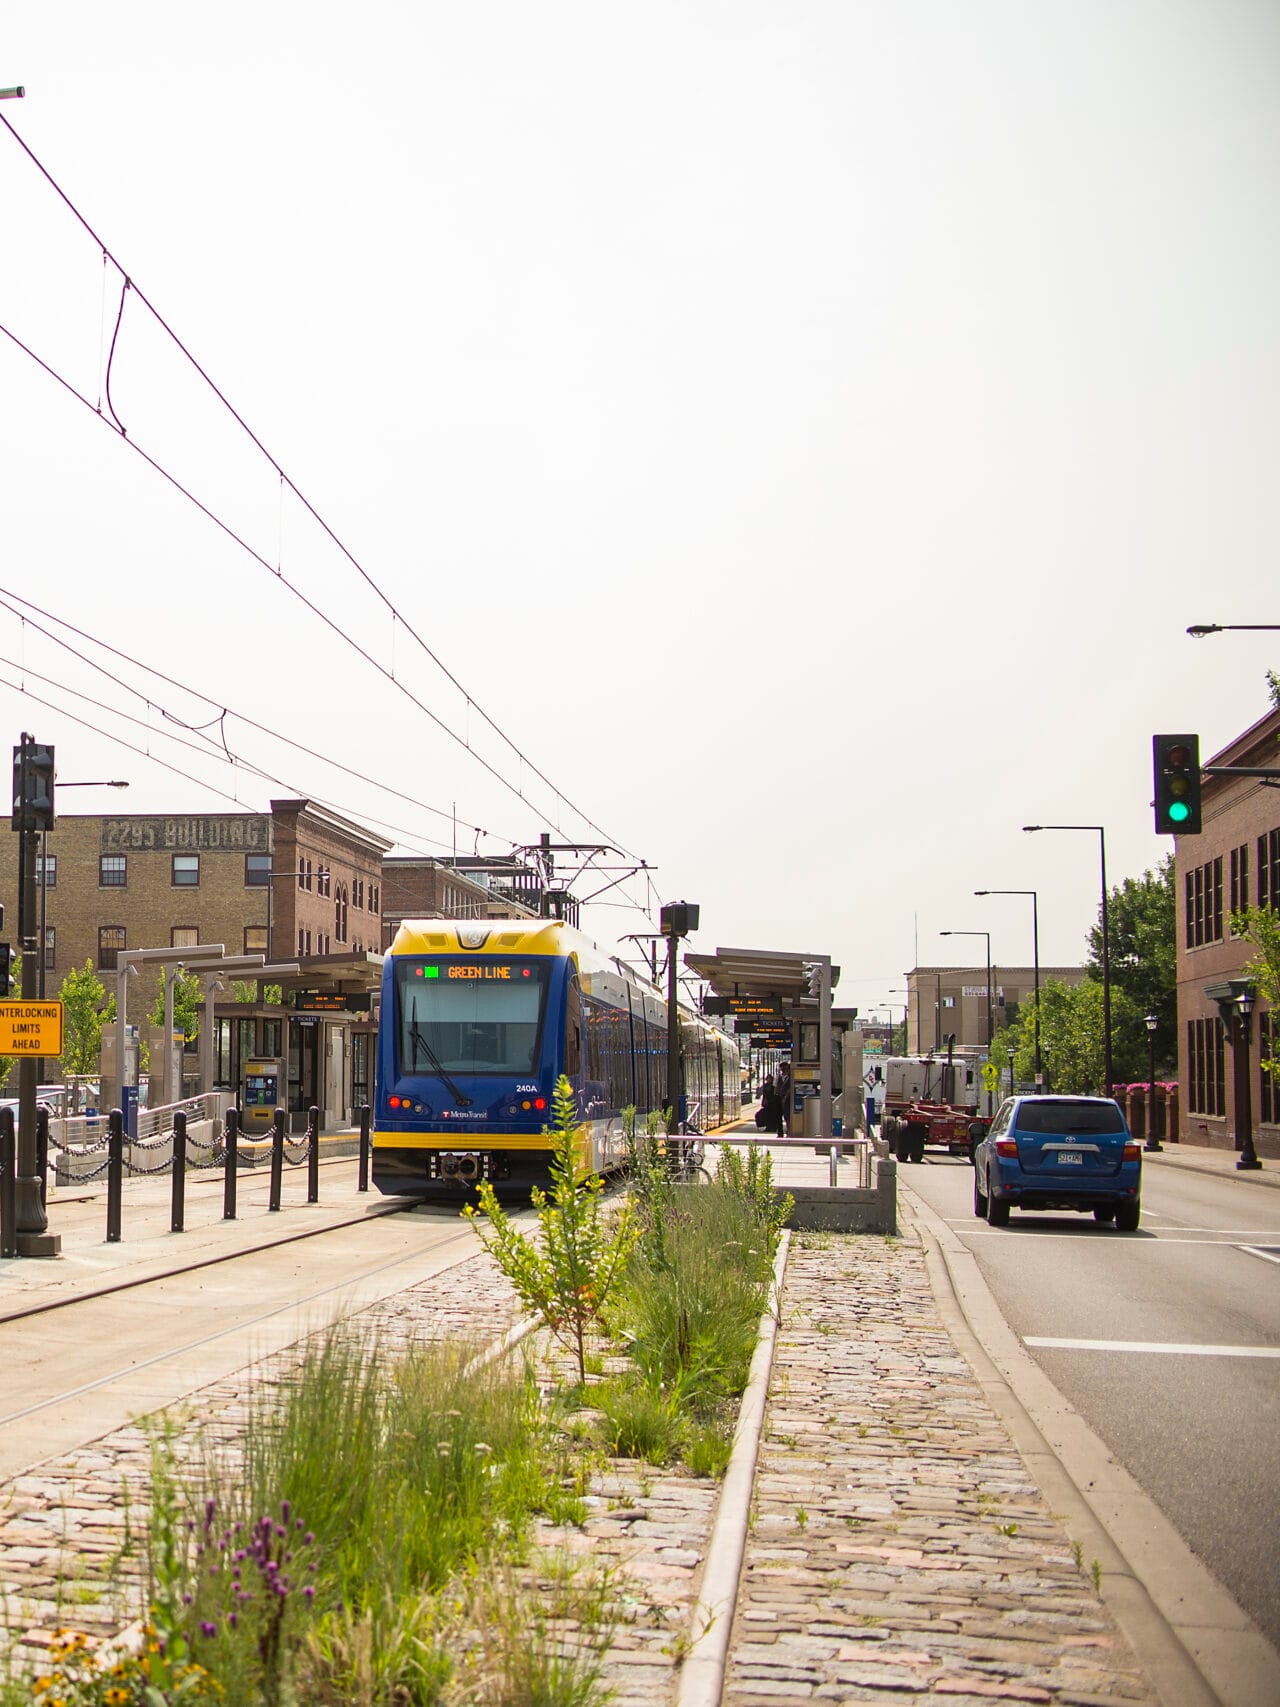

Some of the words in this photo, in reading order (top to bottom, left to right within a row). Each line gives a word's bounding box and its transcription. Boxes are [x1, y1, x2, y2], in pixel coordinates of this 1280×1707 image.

[107, 819, 156, 848] 2295
[164, 818, 260, 848] BUILDING
[448, 966, 482, 979] GREEN
[484, 966, 512, 979] LINE
[12, 1023, 41, 1034] LIMITS
[12, 1039, 41, 1049] AHEAD
[516, 1084, 538, 1093] 240A
